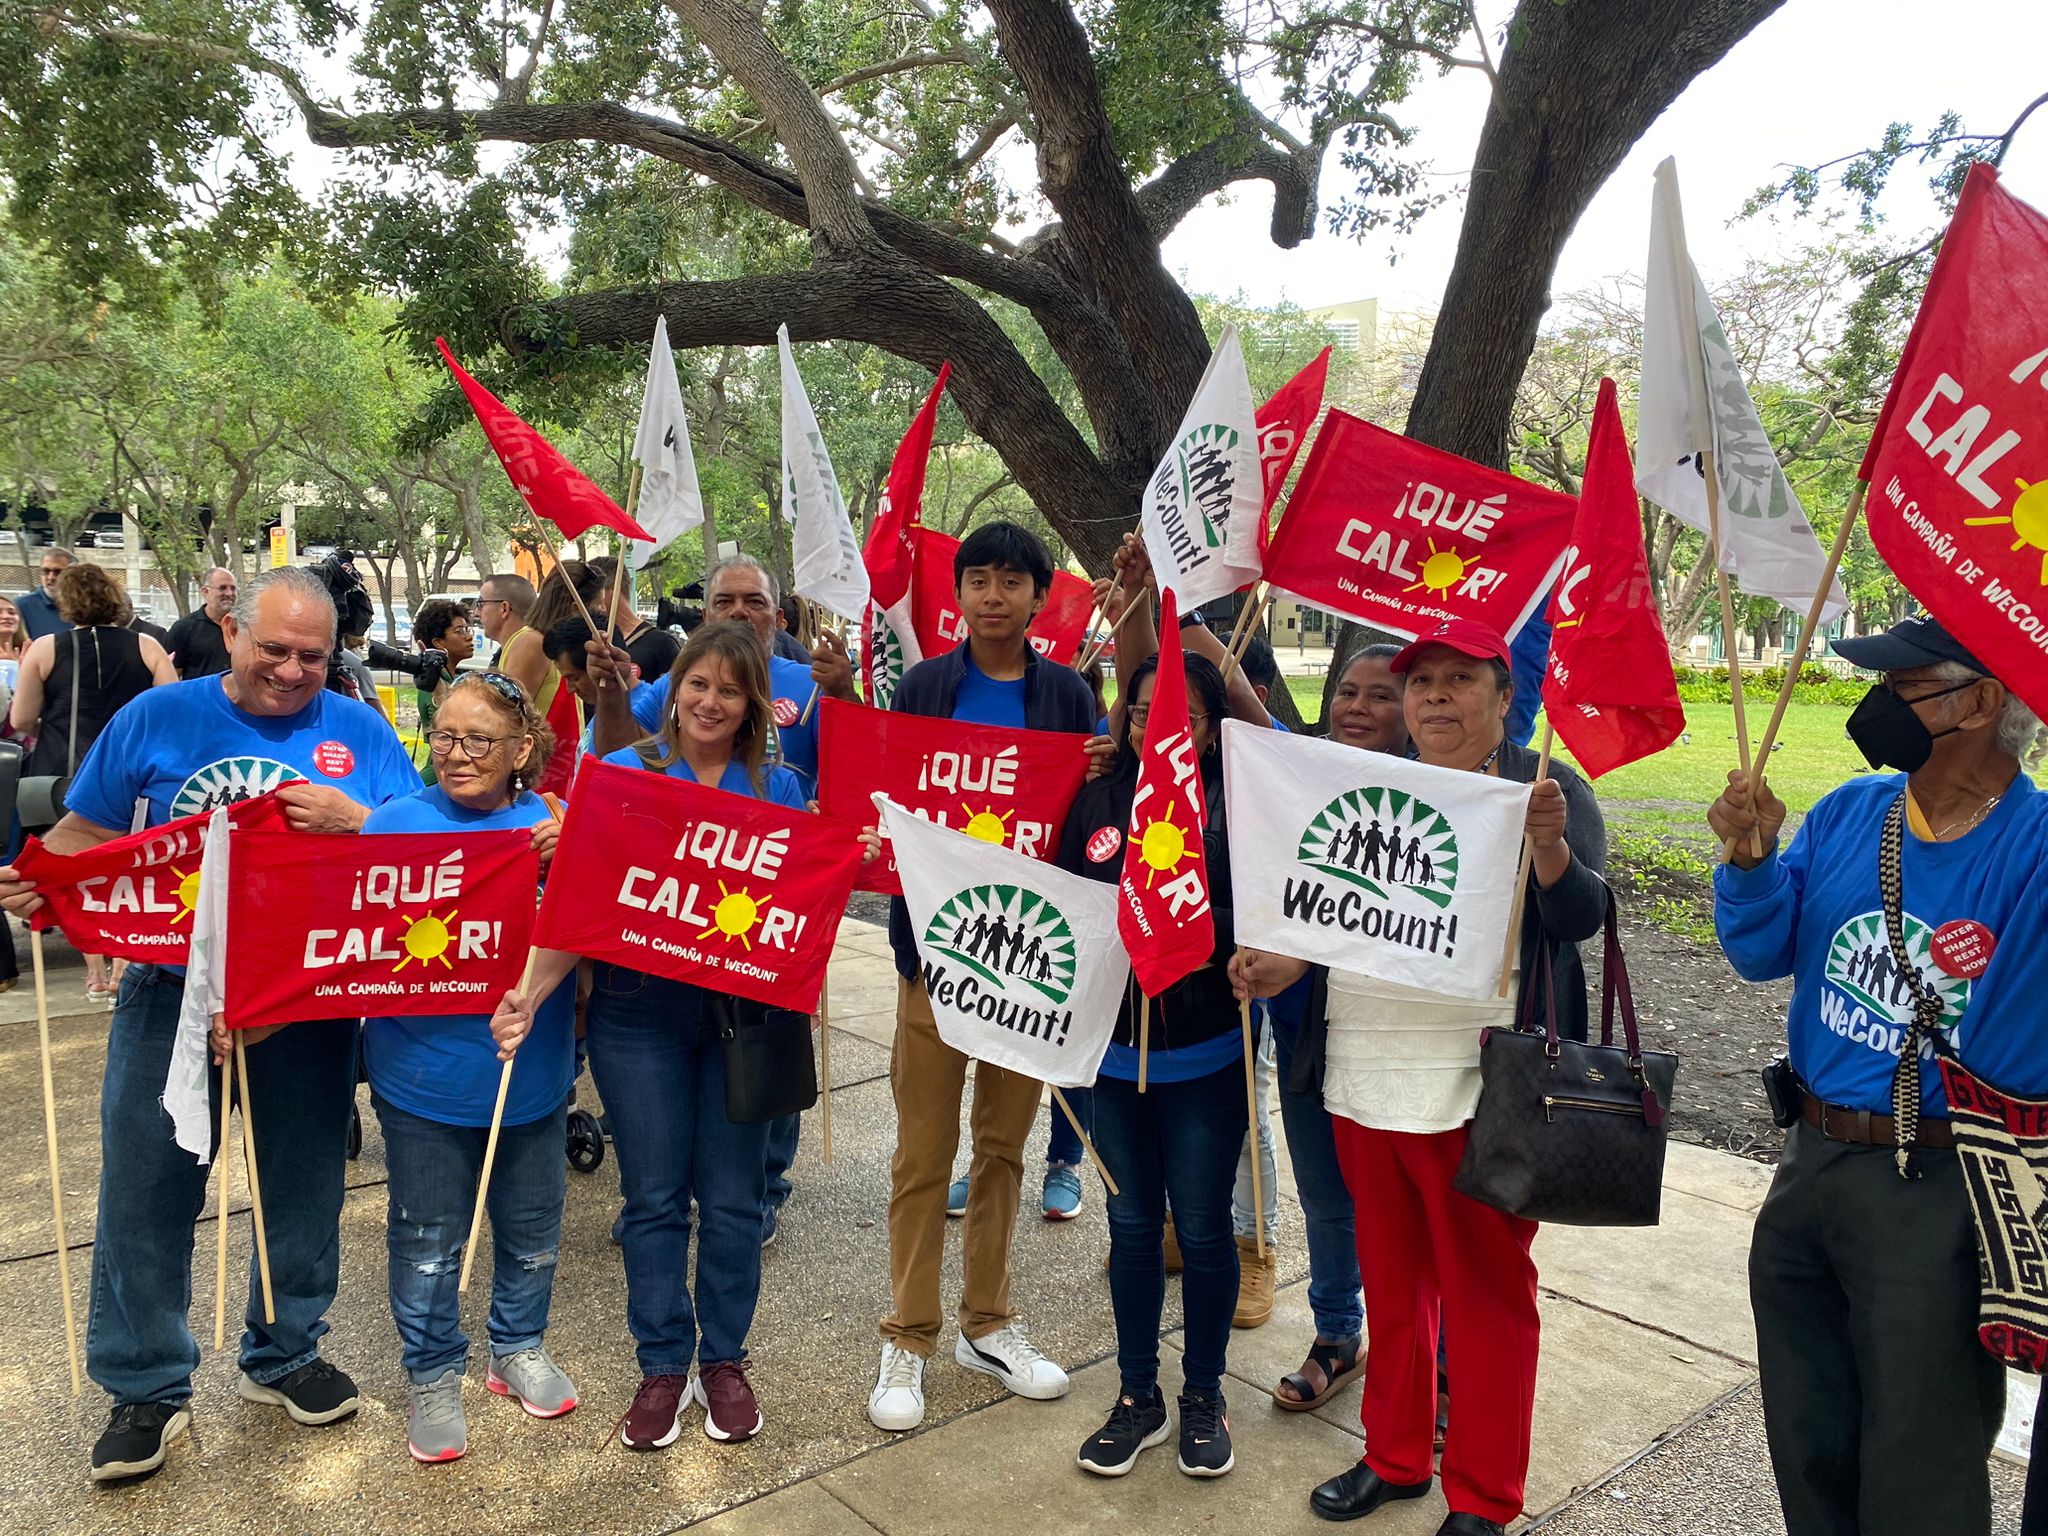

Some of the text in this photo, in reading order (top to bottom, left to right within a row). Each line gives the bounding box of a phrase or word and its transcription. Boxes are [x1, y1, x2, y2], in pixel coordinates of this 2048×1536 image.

[1393, 482, 1507, 542] ¡QUÉ
[1885, 475, 1905, 508] UNA
[1902, 501, 1957, 564] CAMPAÑA
[1955, 558, 1984, 584] DE
[1337, 577, 1359, 595] UNA
[1362, 588, 1402, 610] CAMPAÑA
[1403, 603, 1417, 613] DE
[918, 745, 1019, 795] ¡QUÉ
[674, 821, 790, 880] ¡QUÉ
[352, 848, 464, 911] ¡QUÉ
[1122, 877, 1153, 938] WECOUNT
[1283, 877, 1457, 958] WeCount!
[128, 932, 186, 945] CAMPAÑA
[621, 929, 778, 983] UNA CAMPAÑA DE WECOUNT
[1936, 923, 1974, 944] WATER
[1943, 934, 1980, 954] SHADE
[1954, 946, 1981, 963] REST
[313, 981, 488, 996] UNA CAMPAÑA DE WECOUNT
[1962, 957, 1987, 972] NOW
